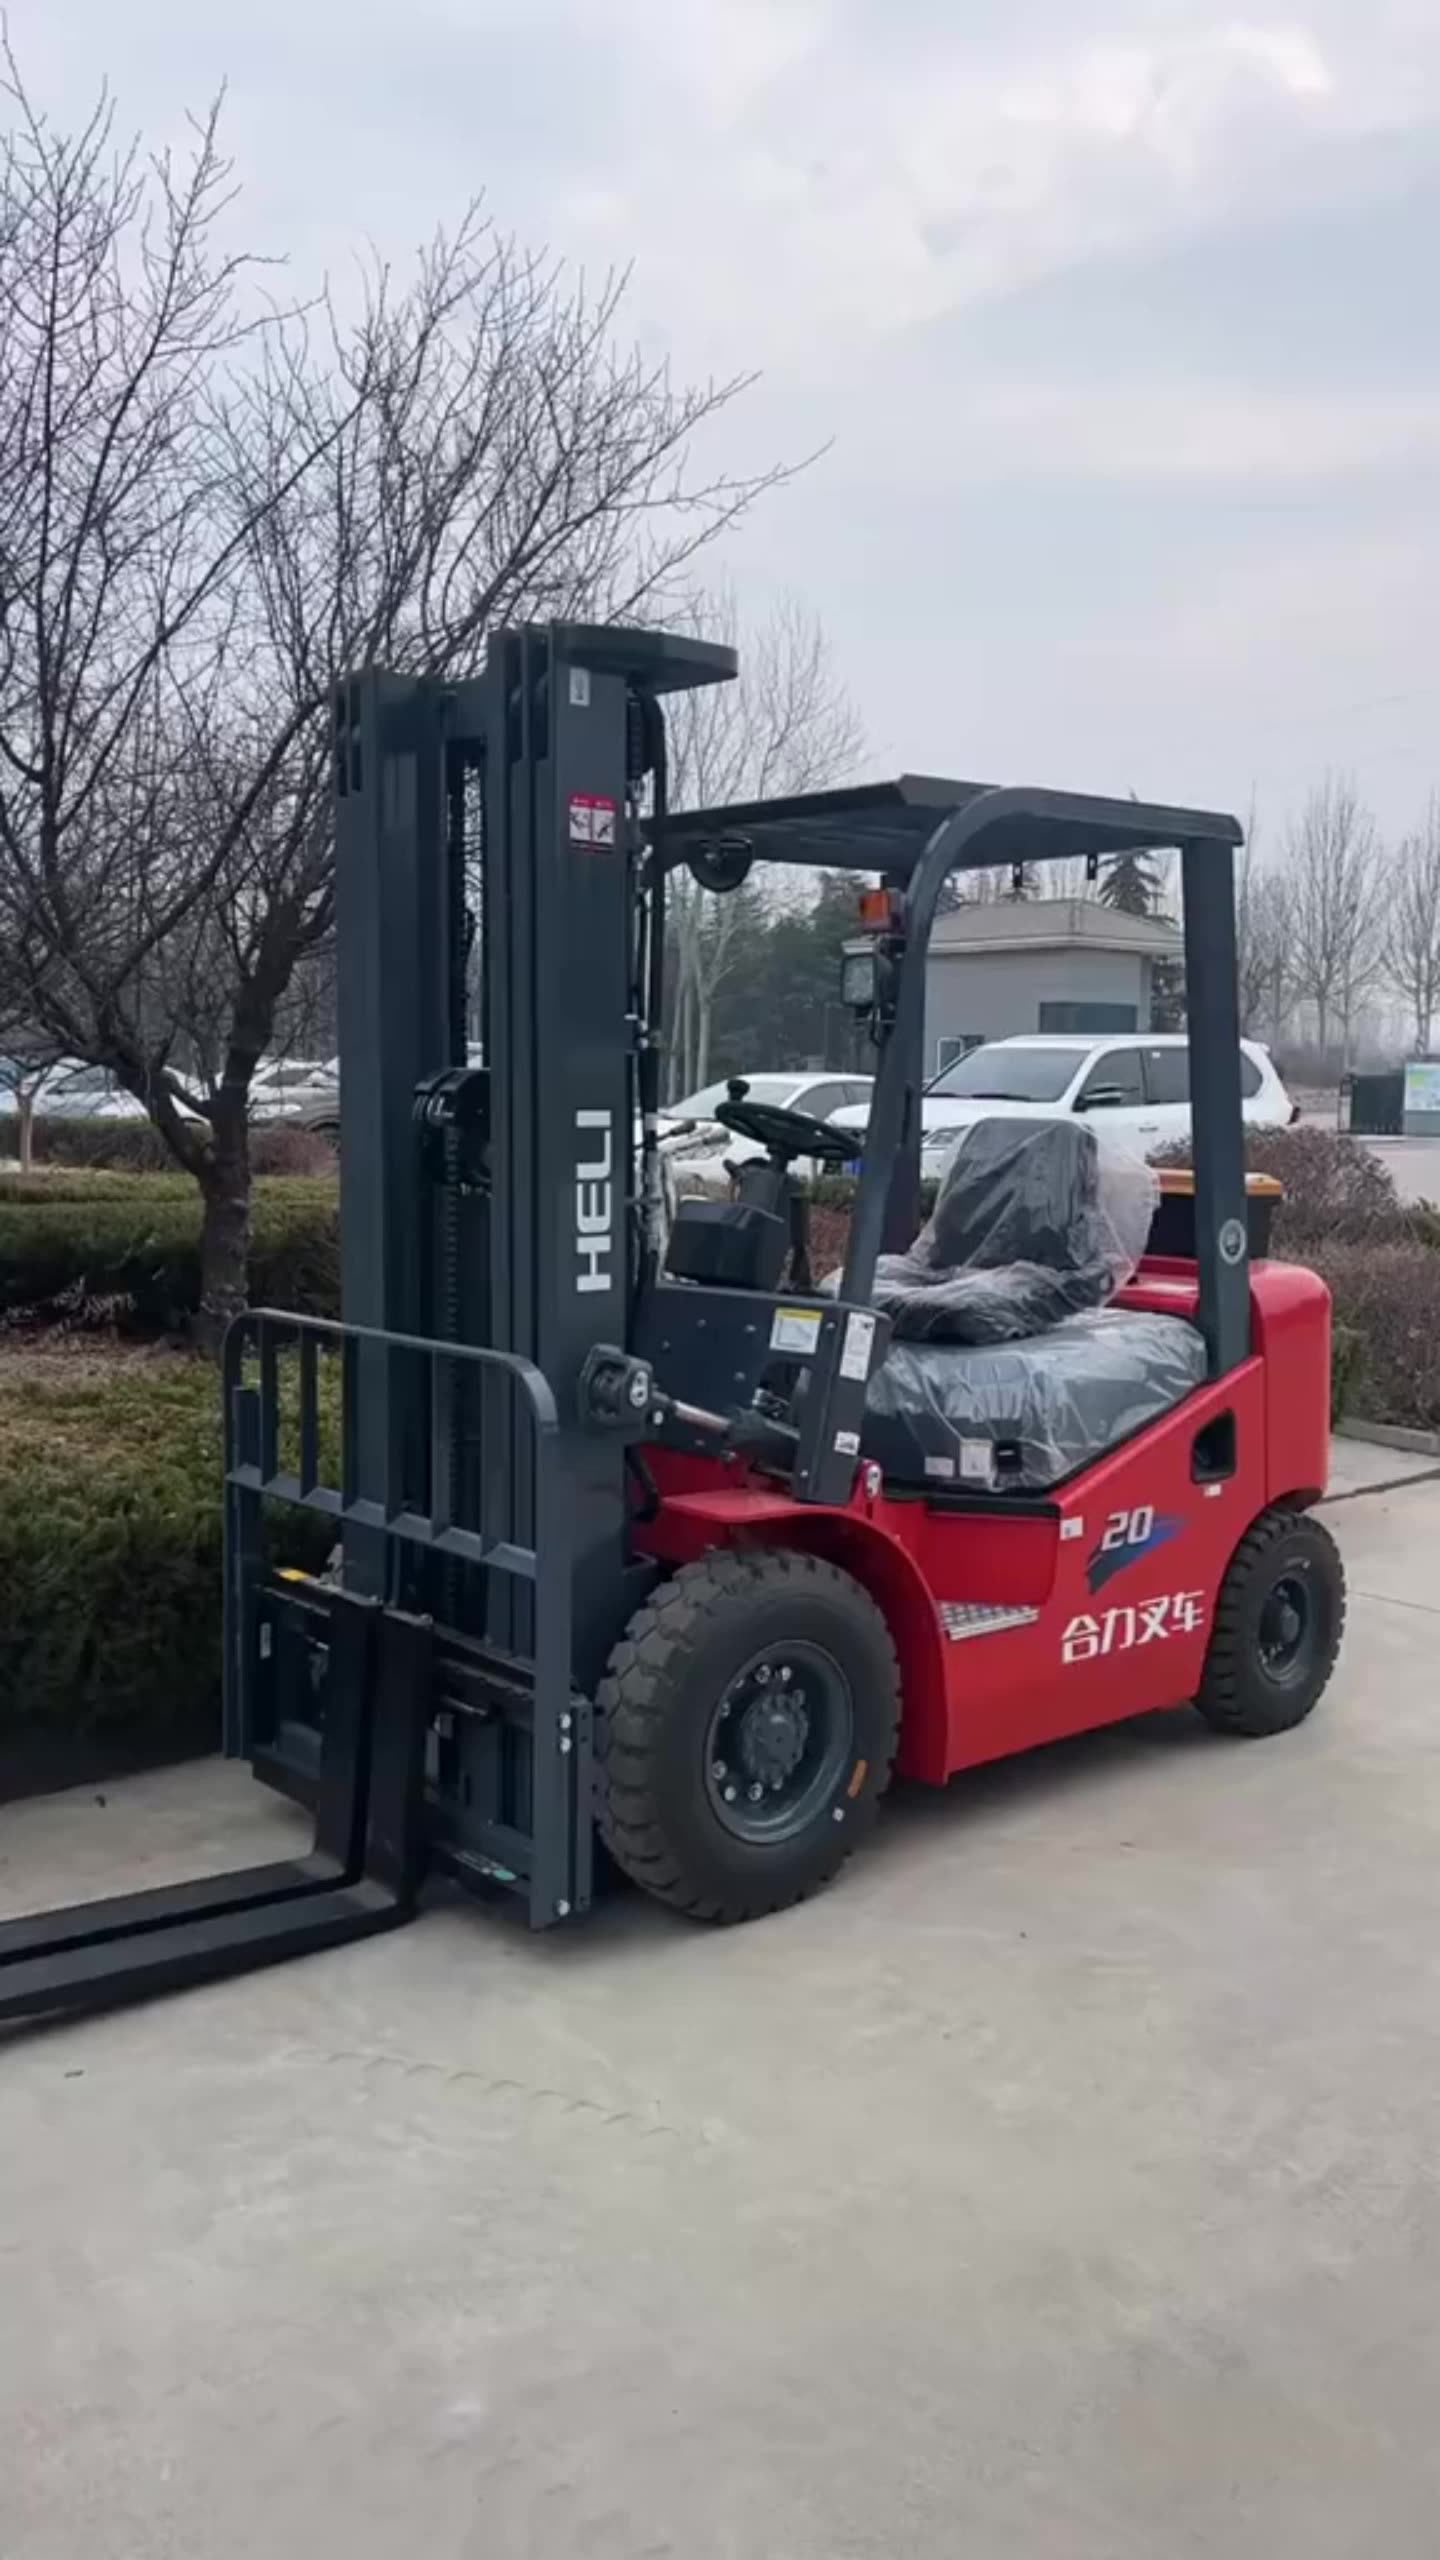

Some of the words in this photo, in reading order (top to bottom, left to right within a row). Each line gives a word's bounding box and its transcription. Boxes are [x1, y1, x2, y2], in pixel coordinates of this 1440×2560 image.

[576, 1109, 611, 1292] HELI
[1101, 1505, 1154, 1551] 20
[1061, 1589, 1205, 1664] 合力叉车
